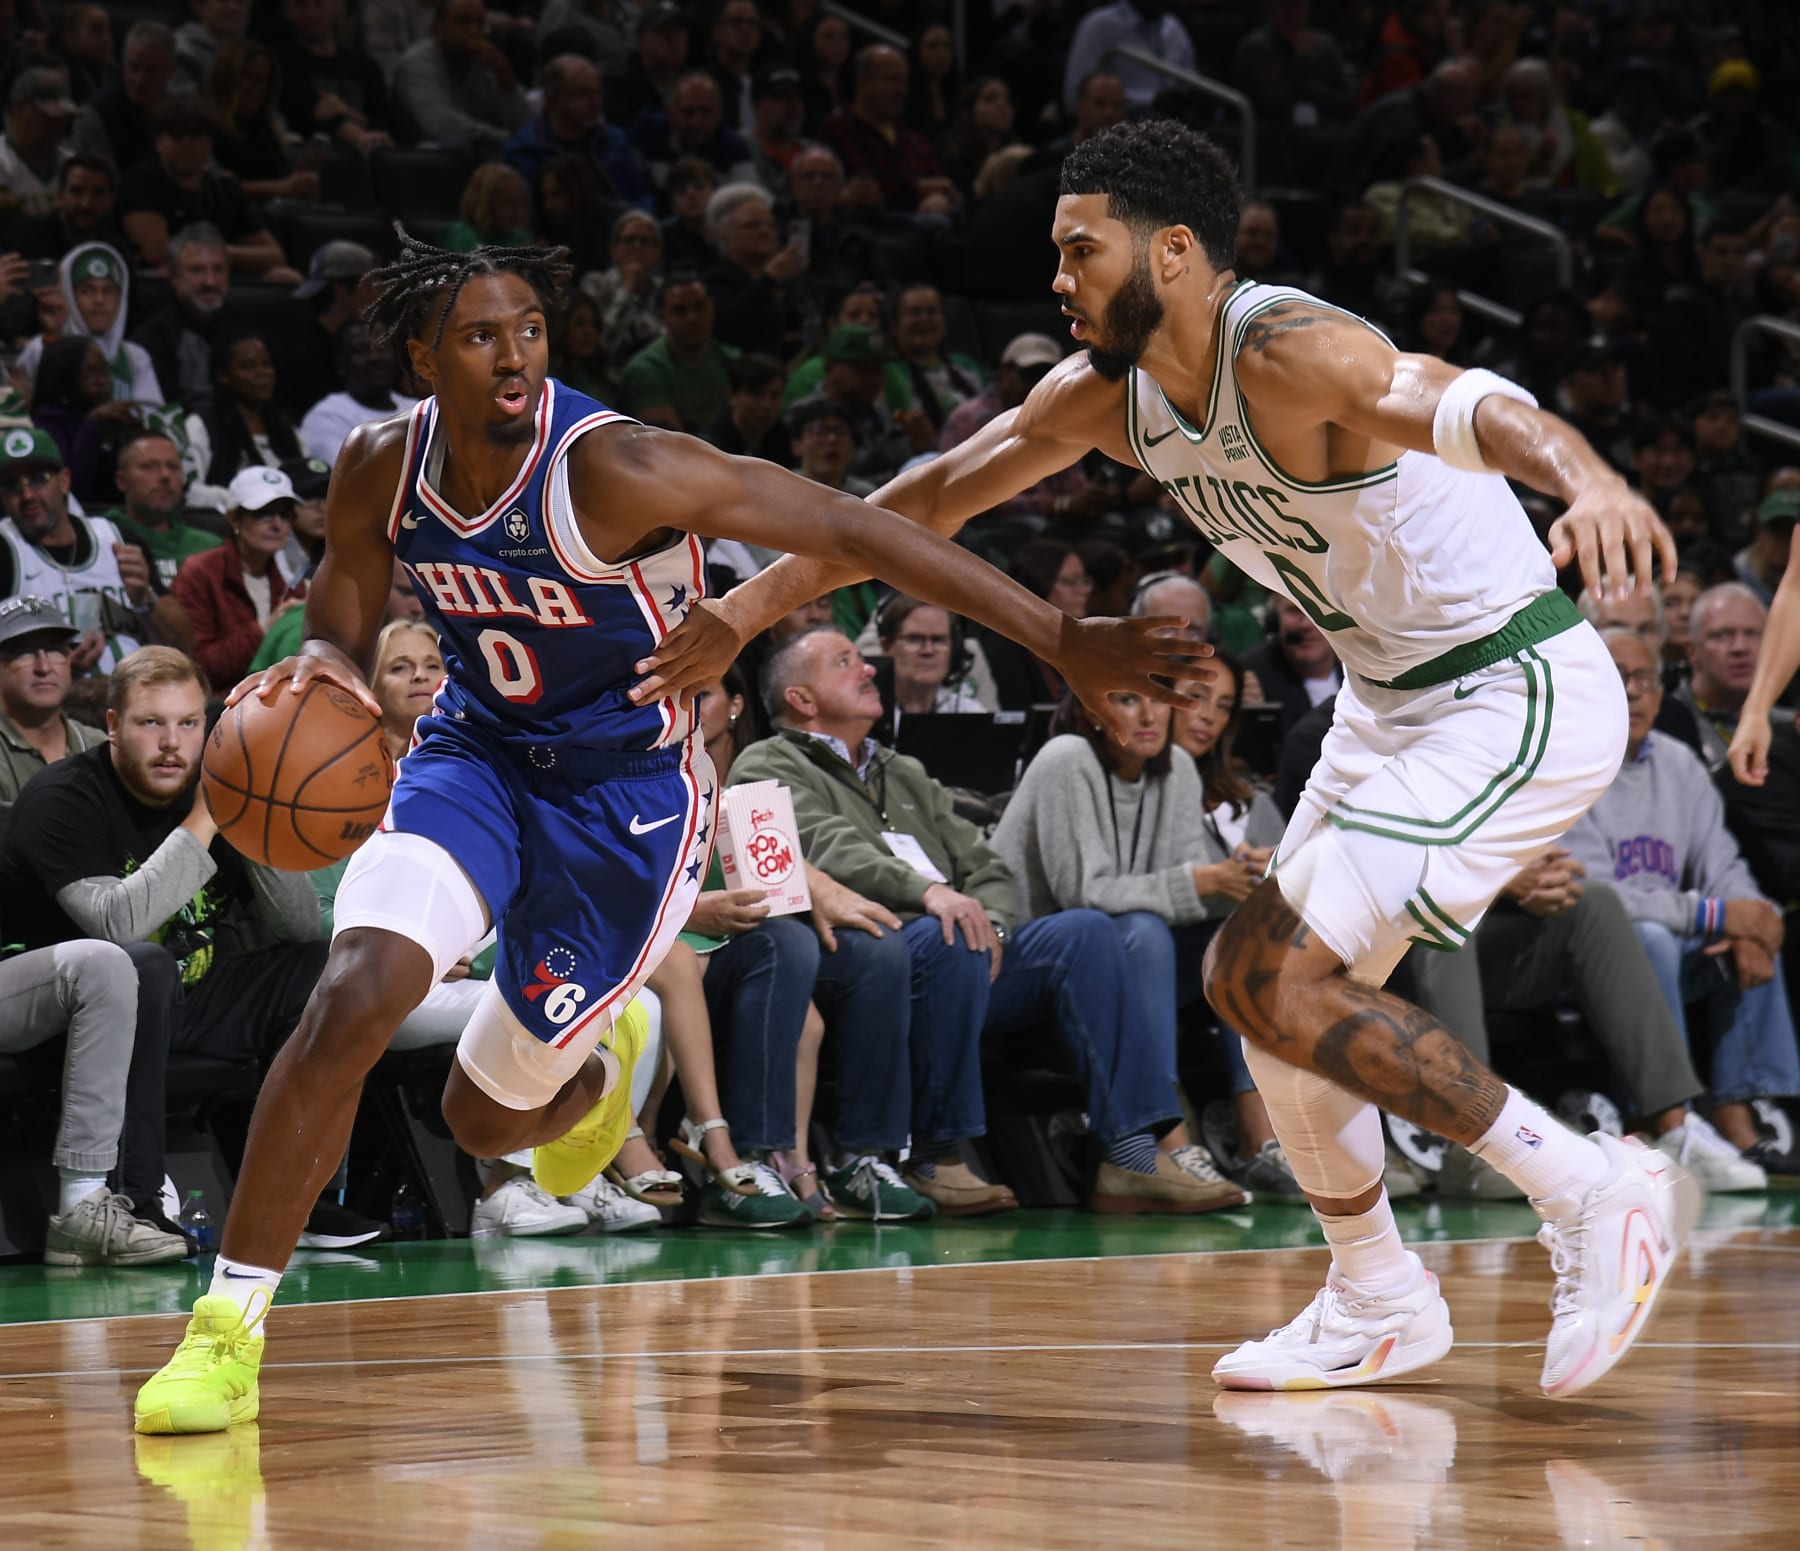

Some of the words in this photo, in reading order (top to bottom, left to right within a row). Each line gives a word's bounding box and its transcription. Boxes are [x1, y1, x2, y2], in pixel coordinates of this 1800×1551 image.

[1218, 424, 1244, 448] VISTA
[1224, 444, 1250, 463] PRINT
[499, 548, 548, 558] crypto.com
[401, 562, 595, 629] HILA
[477, 628, 544, 704] 0
[746, 834, 778, 861] POP
[757, 846, 793, 878] CORN
